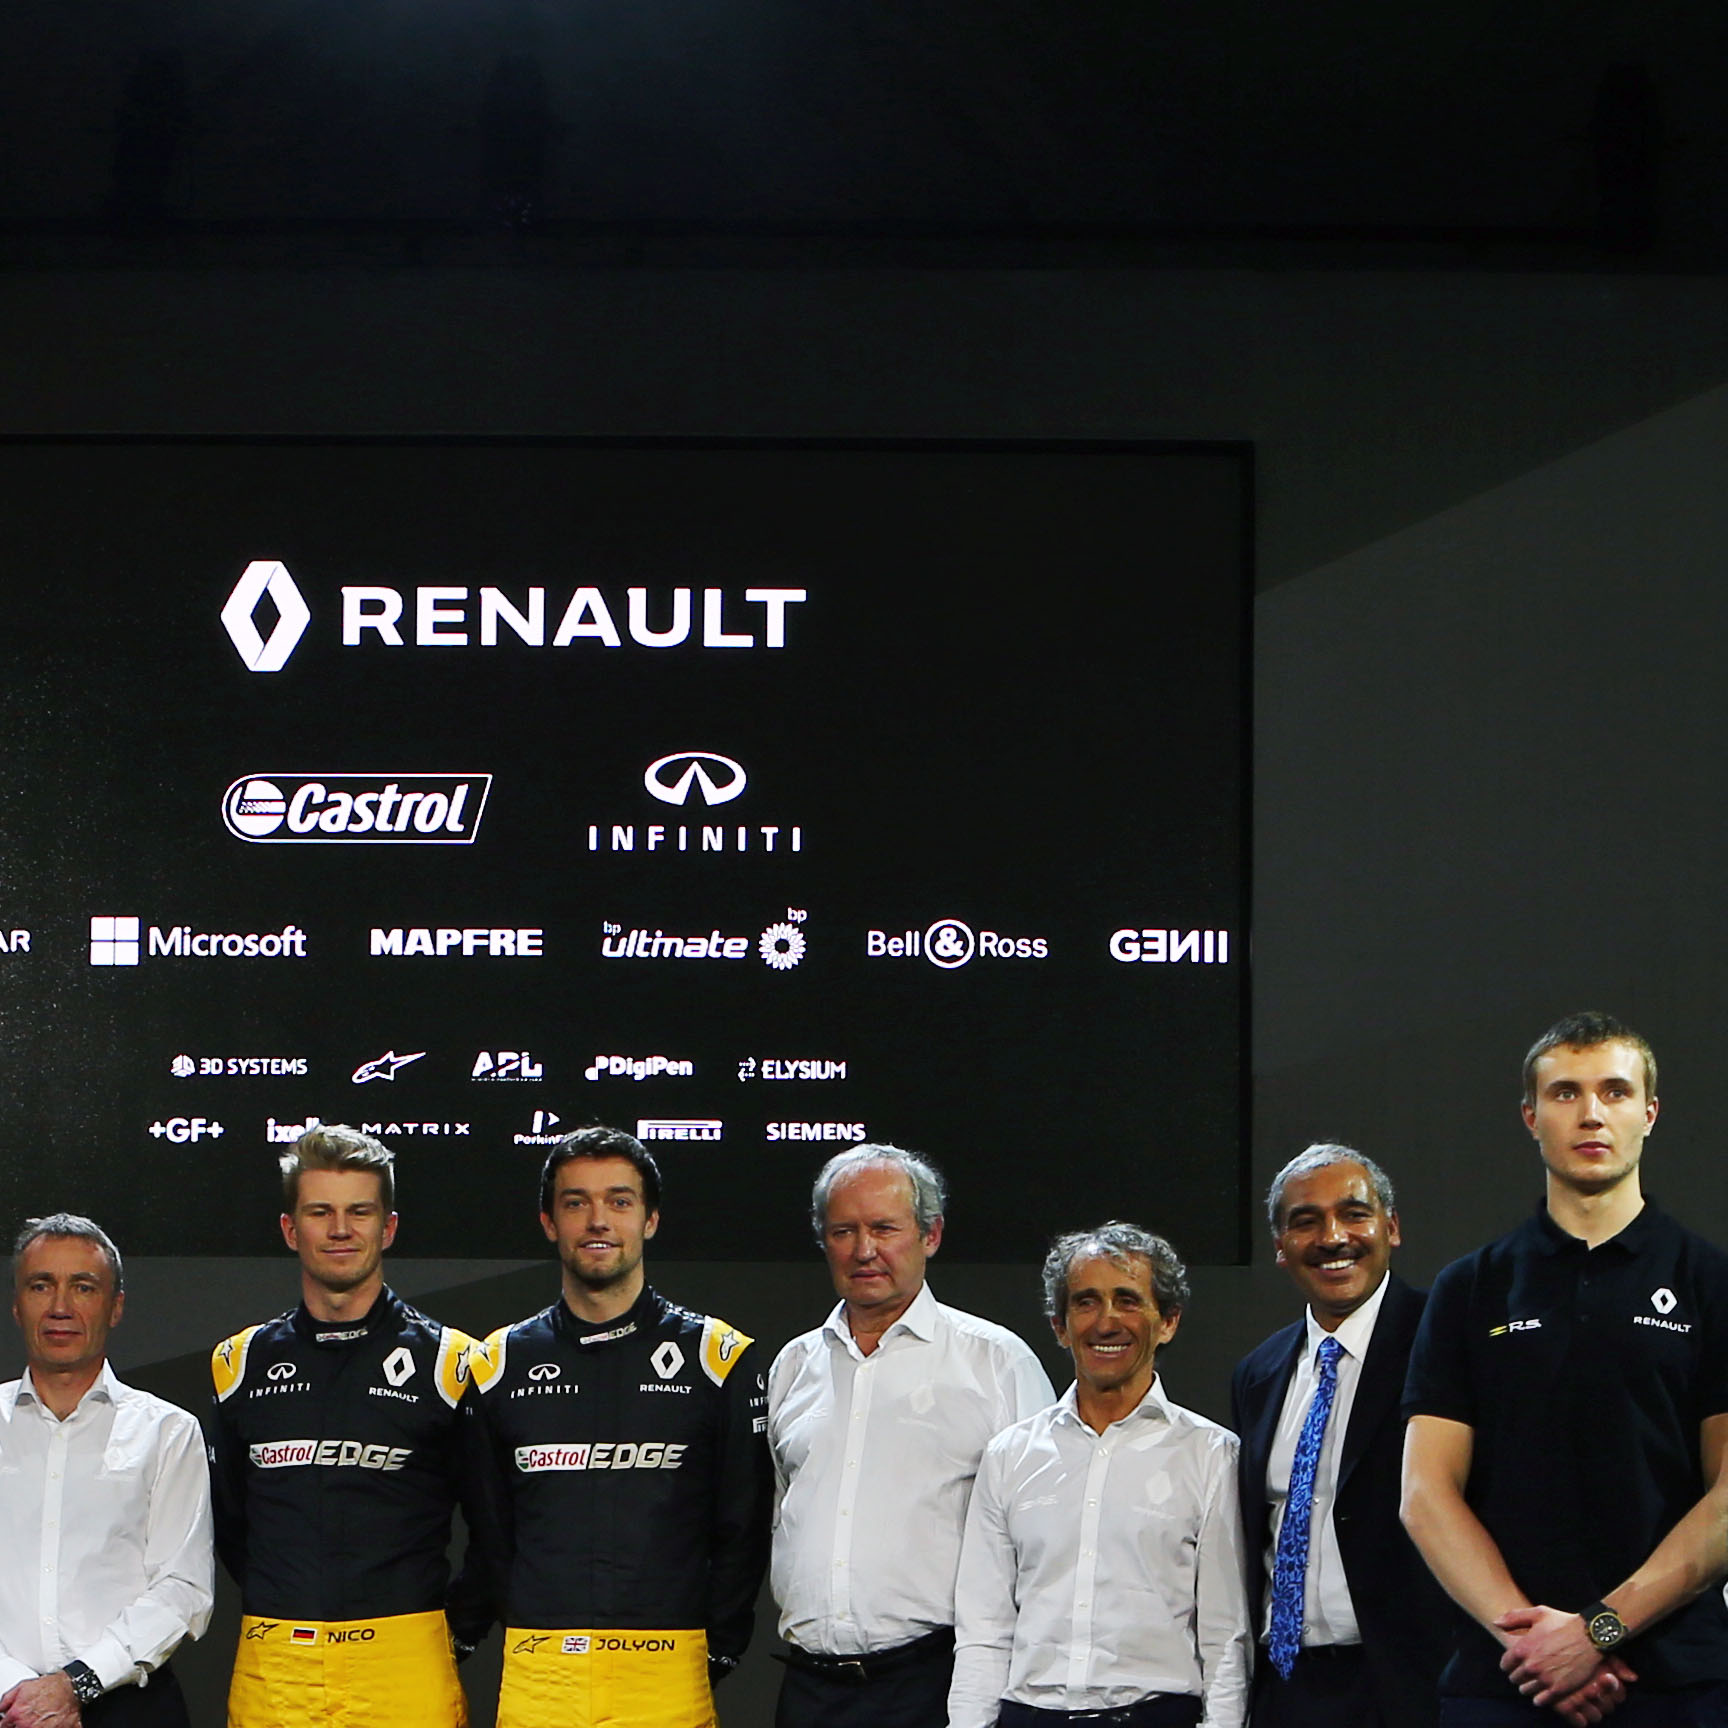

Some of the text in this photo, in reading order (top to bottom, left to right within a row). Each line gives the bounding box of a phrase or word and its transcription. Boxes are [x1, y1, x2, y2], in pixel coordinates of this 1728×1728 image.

[341, 587, 807, 647] RENAULT
[287, 783, 469, 833] Castrol
[588, 825, 801, 852] INFINITI
[787, 907, 808, 925] bp
[603, 921, 621, 937] bp
[149, 926, 307, 958] Microsoft
[371, 929, 543, 956] MAPFRE
[602, 930, 749, 959] ultimate
[867, 930, 920, 957] Bell
[979, 932, 1049, 958] Ross
[199, 1059, 308, 1076] 3D SYSTEMS
[761, 1060, 847, 1080] ELYSIUM
[361, 1122, 470, 1136] MATRIX
[637, 1119, 723, 1141] PIRELLI
[766, 1122, 867, 1142] SIEMENS
[1633, 1315, 1692, 1334] RENAULT
[249, 1382, 311, 1399] INFINITI
[369, 1386, 419, 1404] RENAULT
[510, 1383, 580, 1399] INFINITI
[639, 1384, 693, 1395] RENAULT
[261, 1440, 414, 1471] Castrol EDGE
[529, 1443, 689, 1470] Castrol EDGE
[327, 1628, 376, 1644] NICO
[595, 1638, 675, 1653] JOLYON
